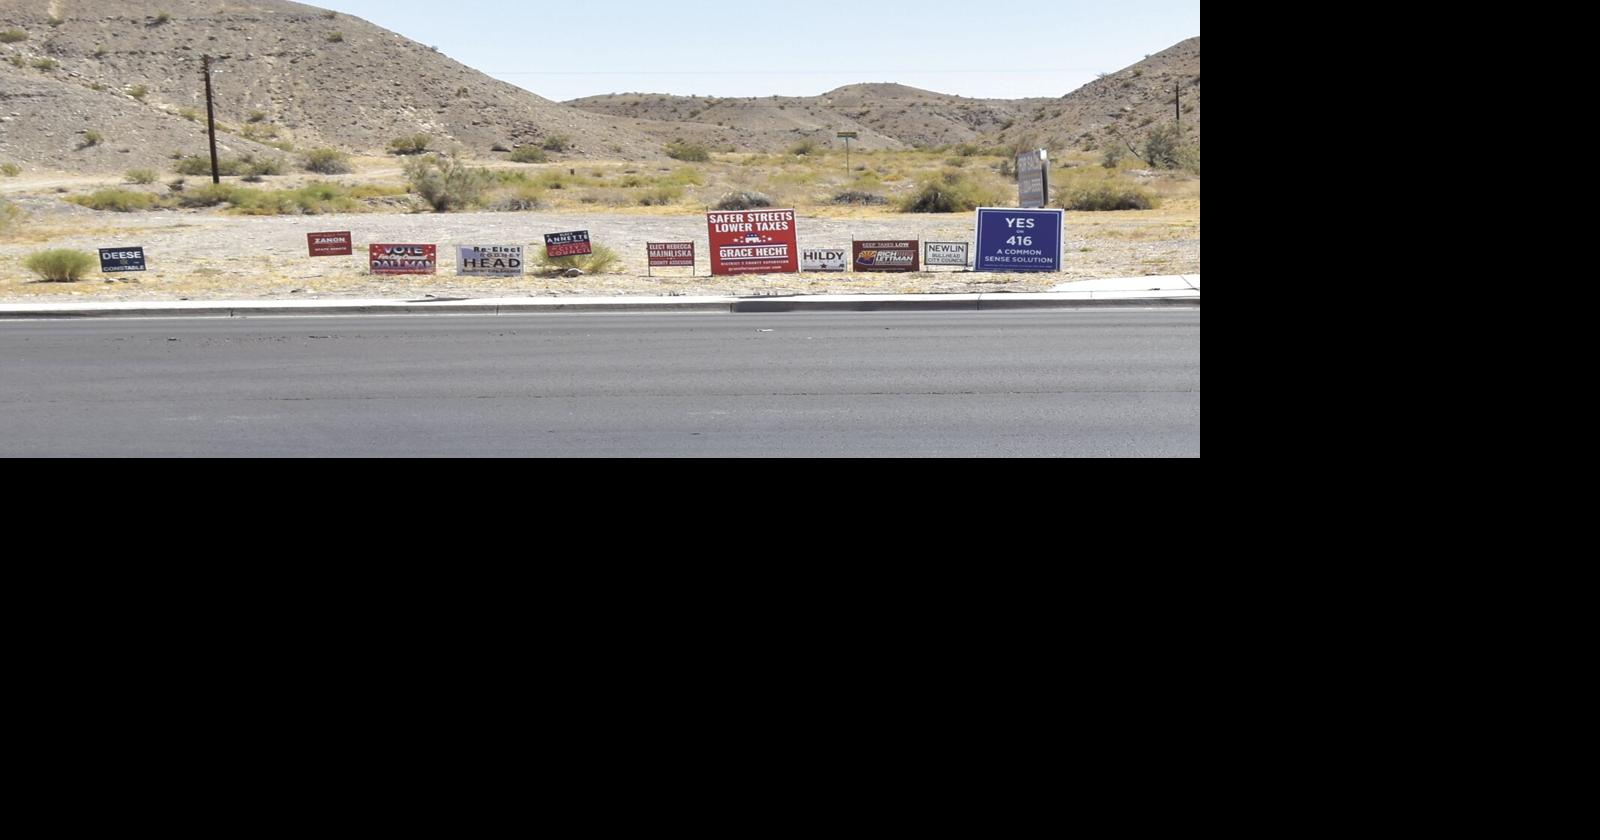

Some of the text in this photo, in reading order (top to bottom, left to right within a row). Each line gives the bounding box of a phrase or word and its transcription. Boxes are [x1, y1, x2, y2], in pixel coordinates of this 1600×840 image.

[709, 212, 793, 224] SAFER STREETS
[715, 221, 789, 233] LOWER TAXES
[1005, 217, 1035, 229] YES
[1006, 235, 1032, 246] 416
[384, 246, 424, 254] VOTE
[720, 247, 788, 258] GRACE HECHT
[928, 244, 965, 253] NEWLIN
[1004, 248, 1042, 256] COMMON
[102, 251, 142, 260] DEESE
[803, 251, 844, 260] HILDY
[984, 255, 1053, 264] SENSE SOLUTION
[463, 258, 521, 268] HEAD
